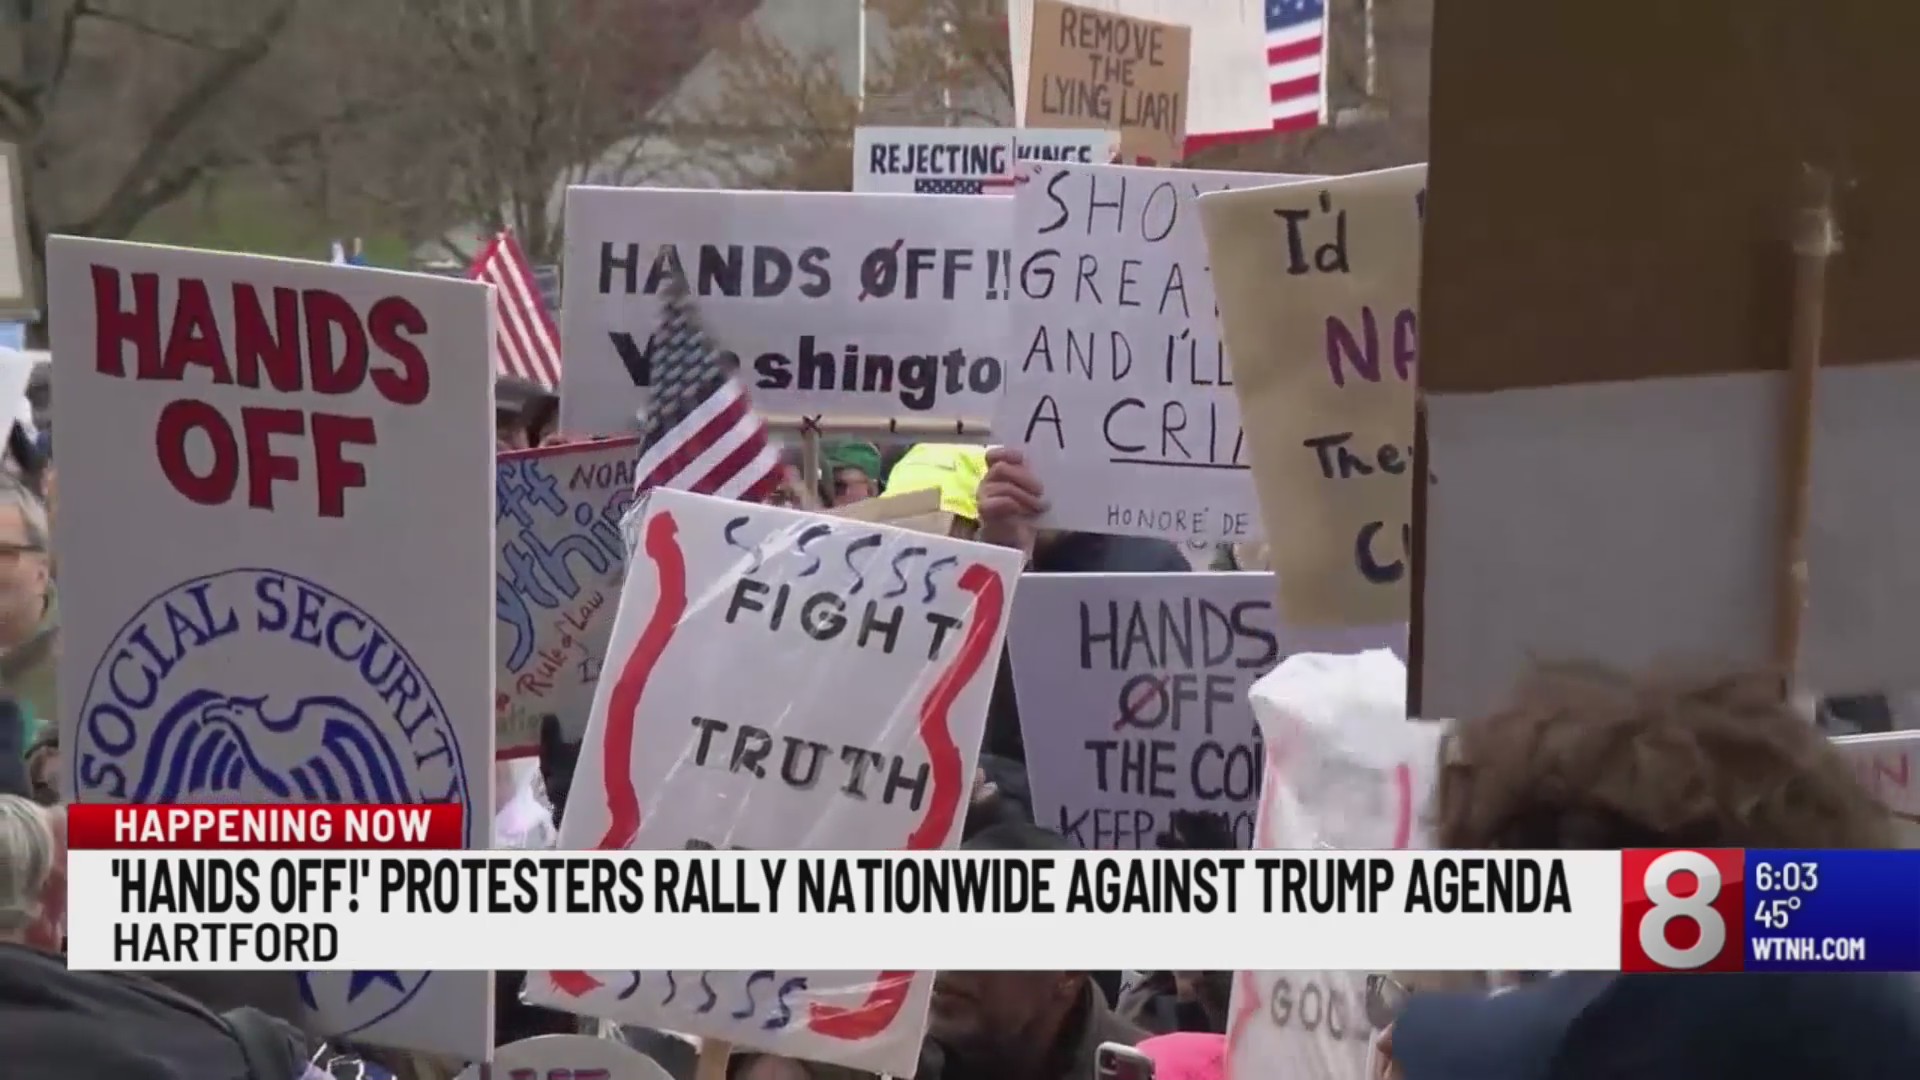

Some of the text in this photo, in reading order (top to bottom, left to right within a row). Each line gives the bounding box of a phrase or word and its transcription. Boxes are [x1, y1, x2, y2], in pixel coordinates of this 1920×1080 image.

[1059, 7, 1166, 67] REMOVE
[1088, 53, 1136, 87] THE
[1040, 75, 1179, 138] LYING LIAR!
[870, 142, 1006, 175] REJECTING
[1273, 188, 1351, 275] I'd
[599, 240, 833, 298] HANDS
[90, 262, 430, 406] HANDS
[1021, 324, 1234, 387] AND I'LL
[155, 398, 377, 518] OFF
[1024, 395, 1244, 460] A CRI
[1303, 431, 1412, 479] The
[1222, 512, 1249, 536] DE
[569, 591, 605, 633] Law
[724, 577, 963, 661] FIGHT
[1078, 596, 1280, 671] HANDS
[79, 582, 239, 798] SOCIAL
[690, 715, 931, 812] TRUTH
[1084, 739, 1177, 799] THE
